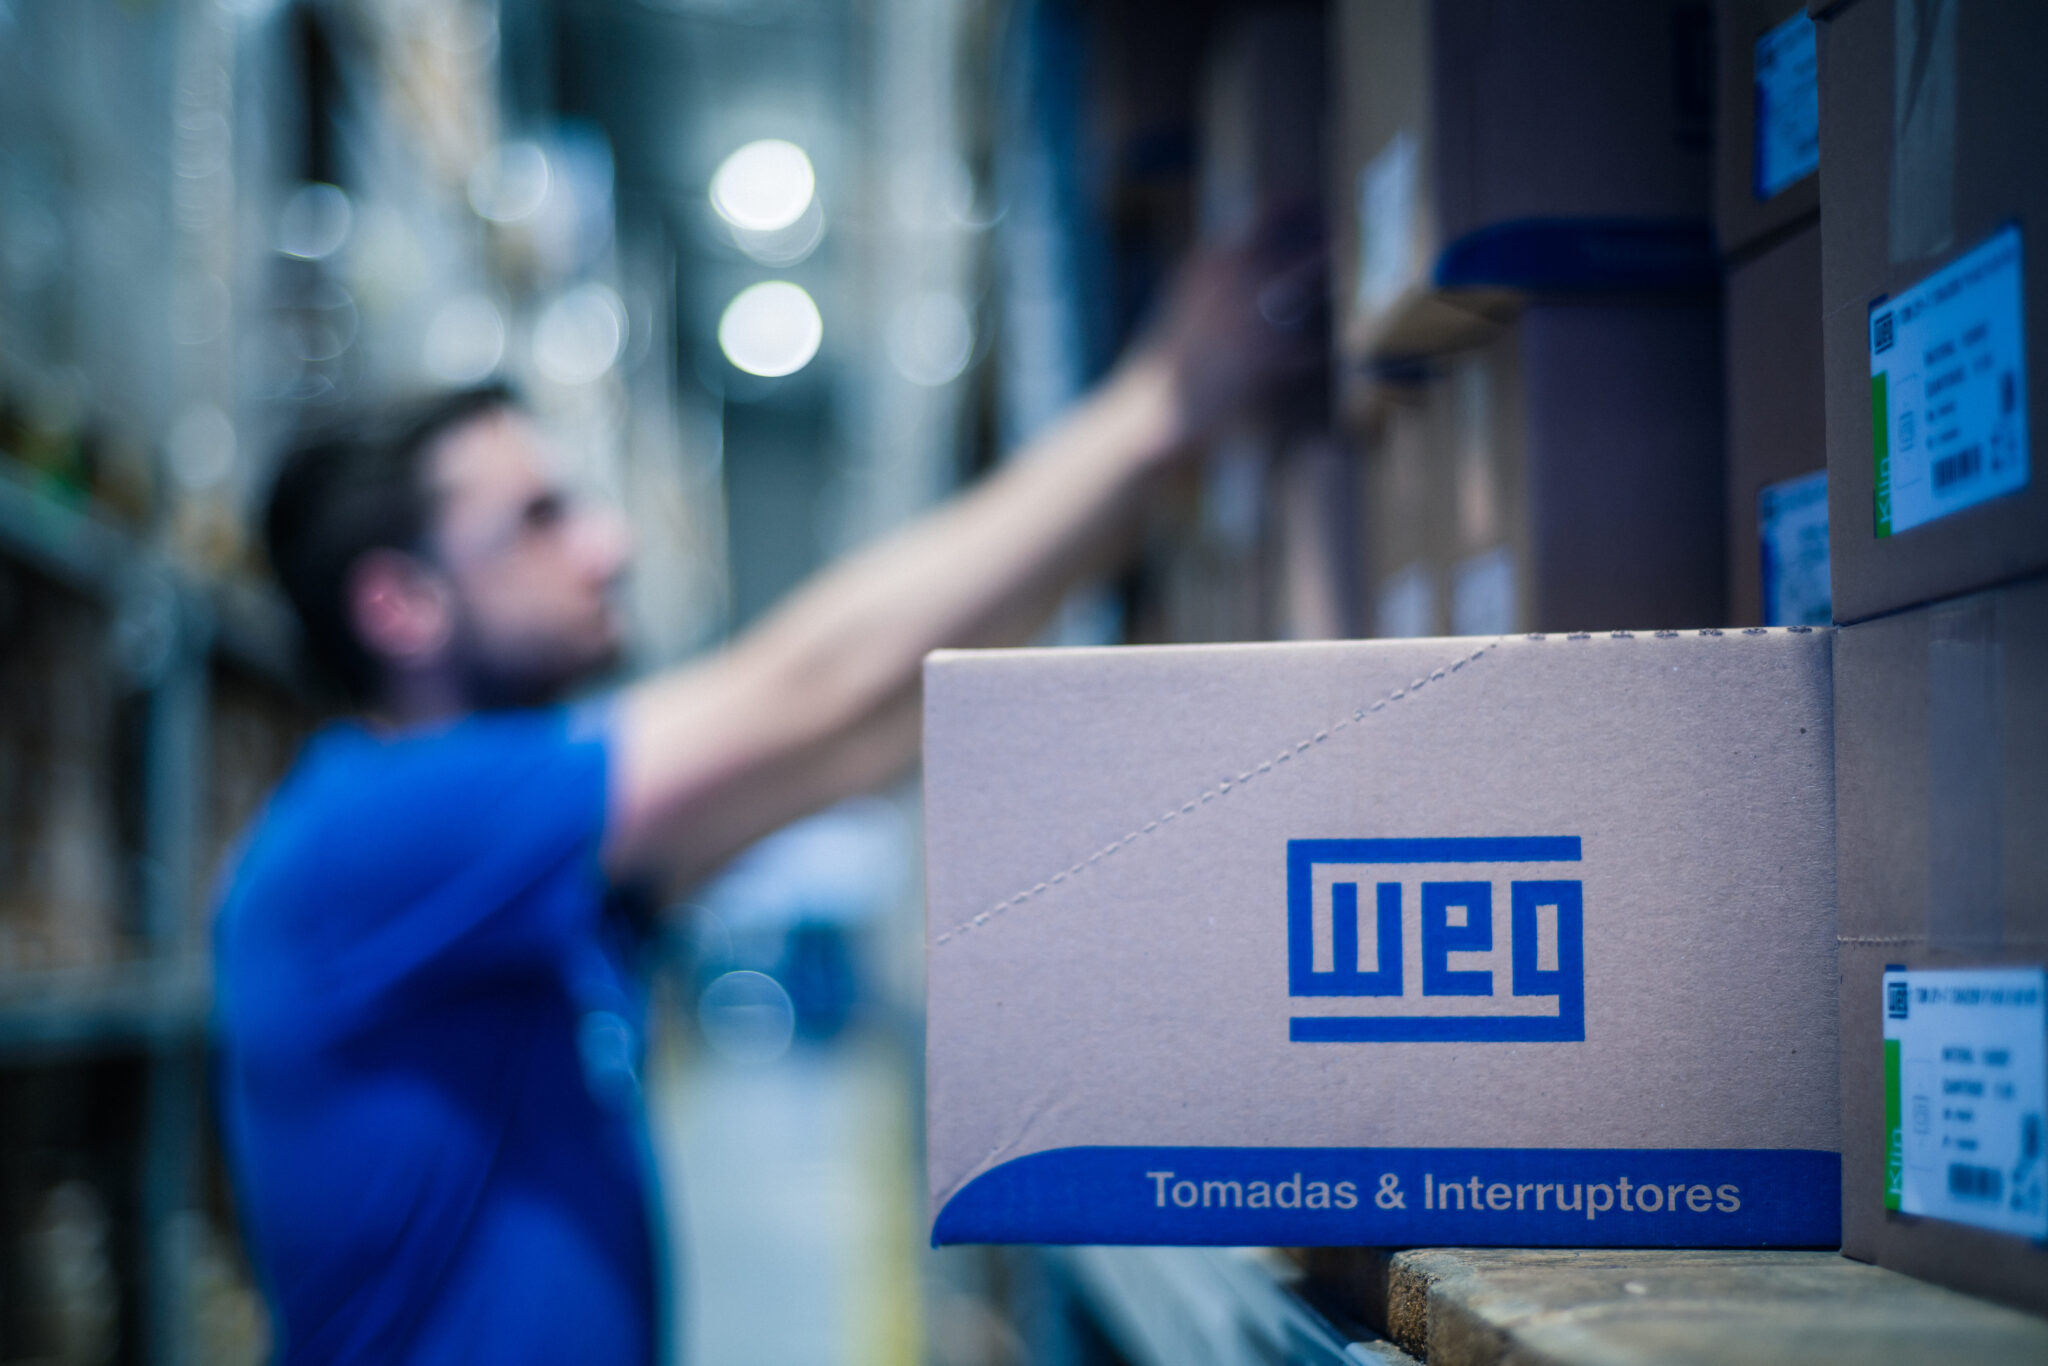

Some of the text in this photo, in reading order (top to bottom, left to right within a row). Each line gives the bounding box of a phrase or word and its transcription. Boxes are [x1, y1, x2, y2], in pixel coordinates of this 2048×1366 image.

[1147, 1171, 1742, 1220] Tomadas & Interruptores
